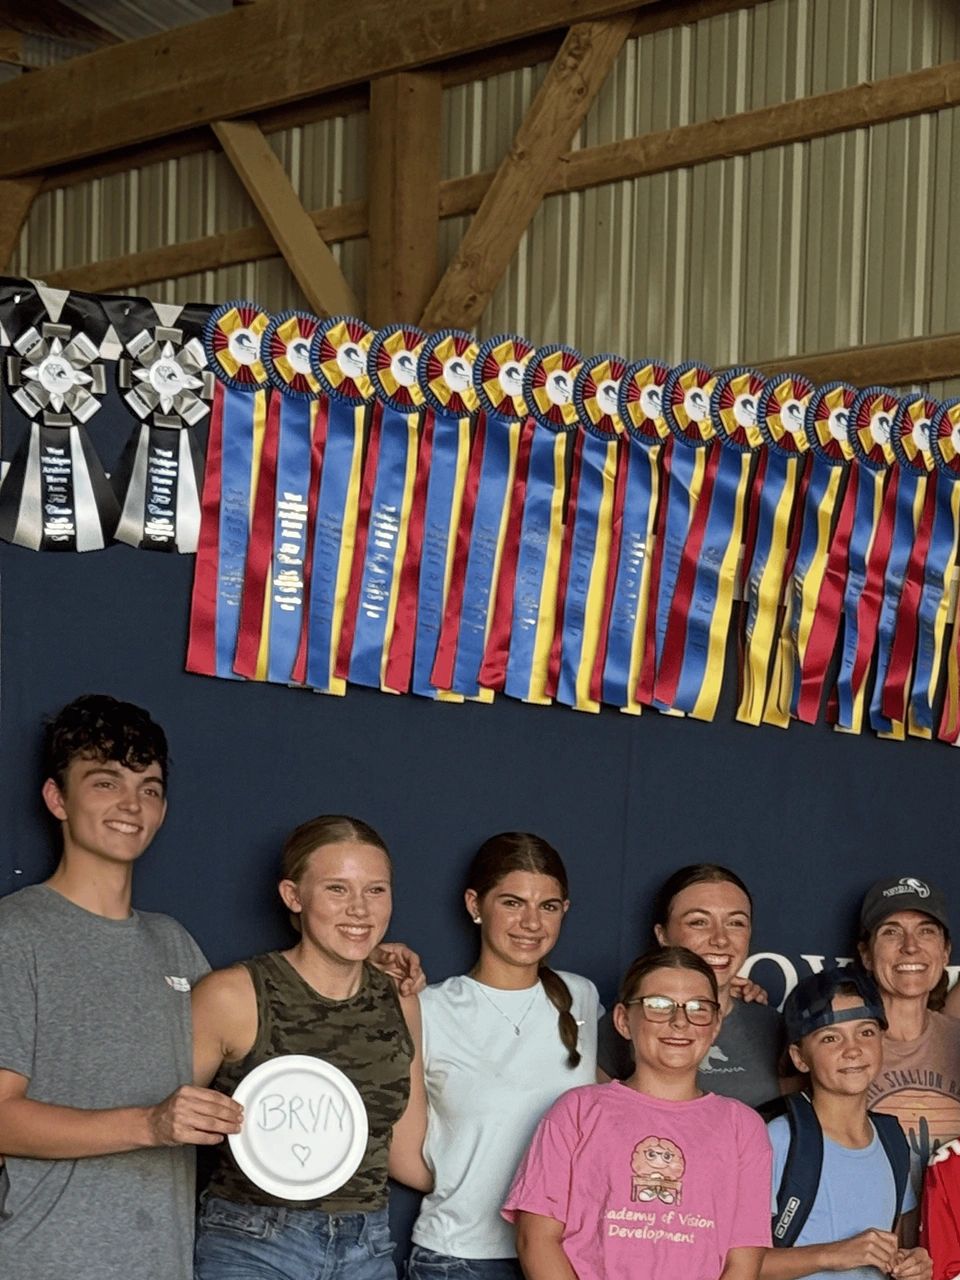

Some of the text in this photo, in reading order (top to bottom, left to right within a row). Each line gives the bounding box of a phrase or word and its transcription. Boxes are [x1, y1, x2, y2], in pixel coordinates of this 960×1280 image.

[883, 1069, 943, 1089] STALLION
[257, 1093, 347, 1133] BRYN
[604, 1207, 715, 1229] ademy of Vision
[608, 1224, 695, 1244] Development
